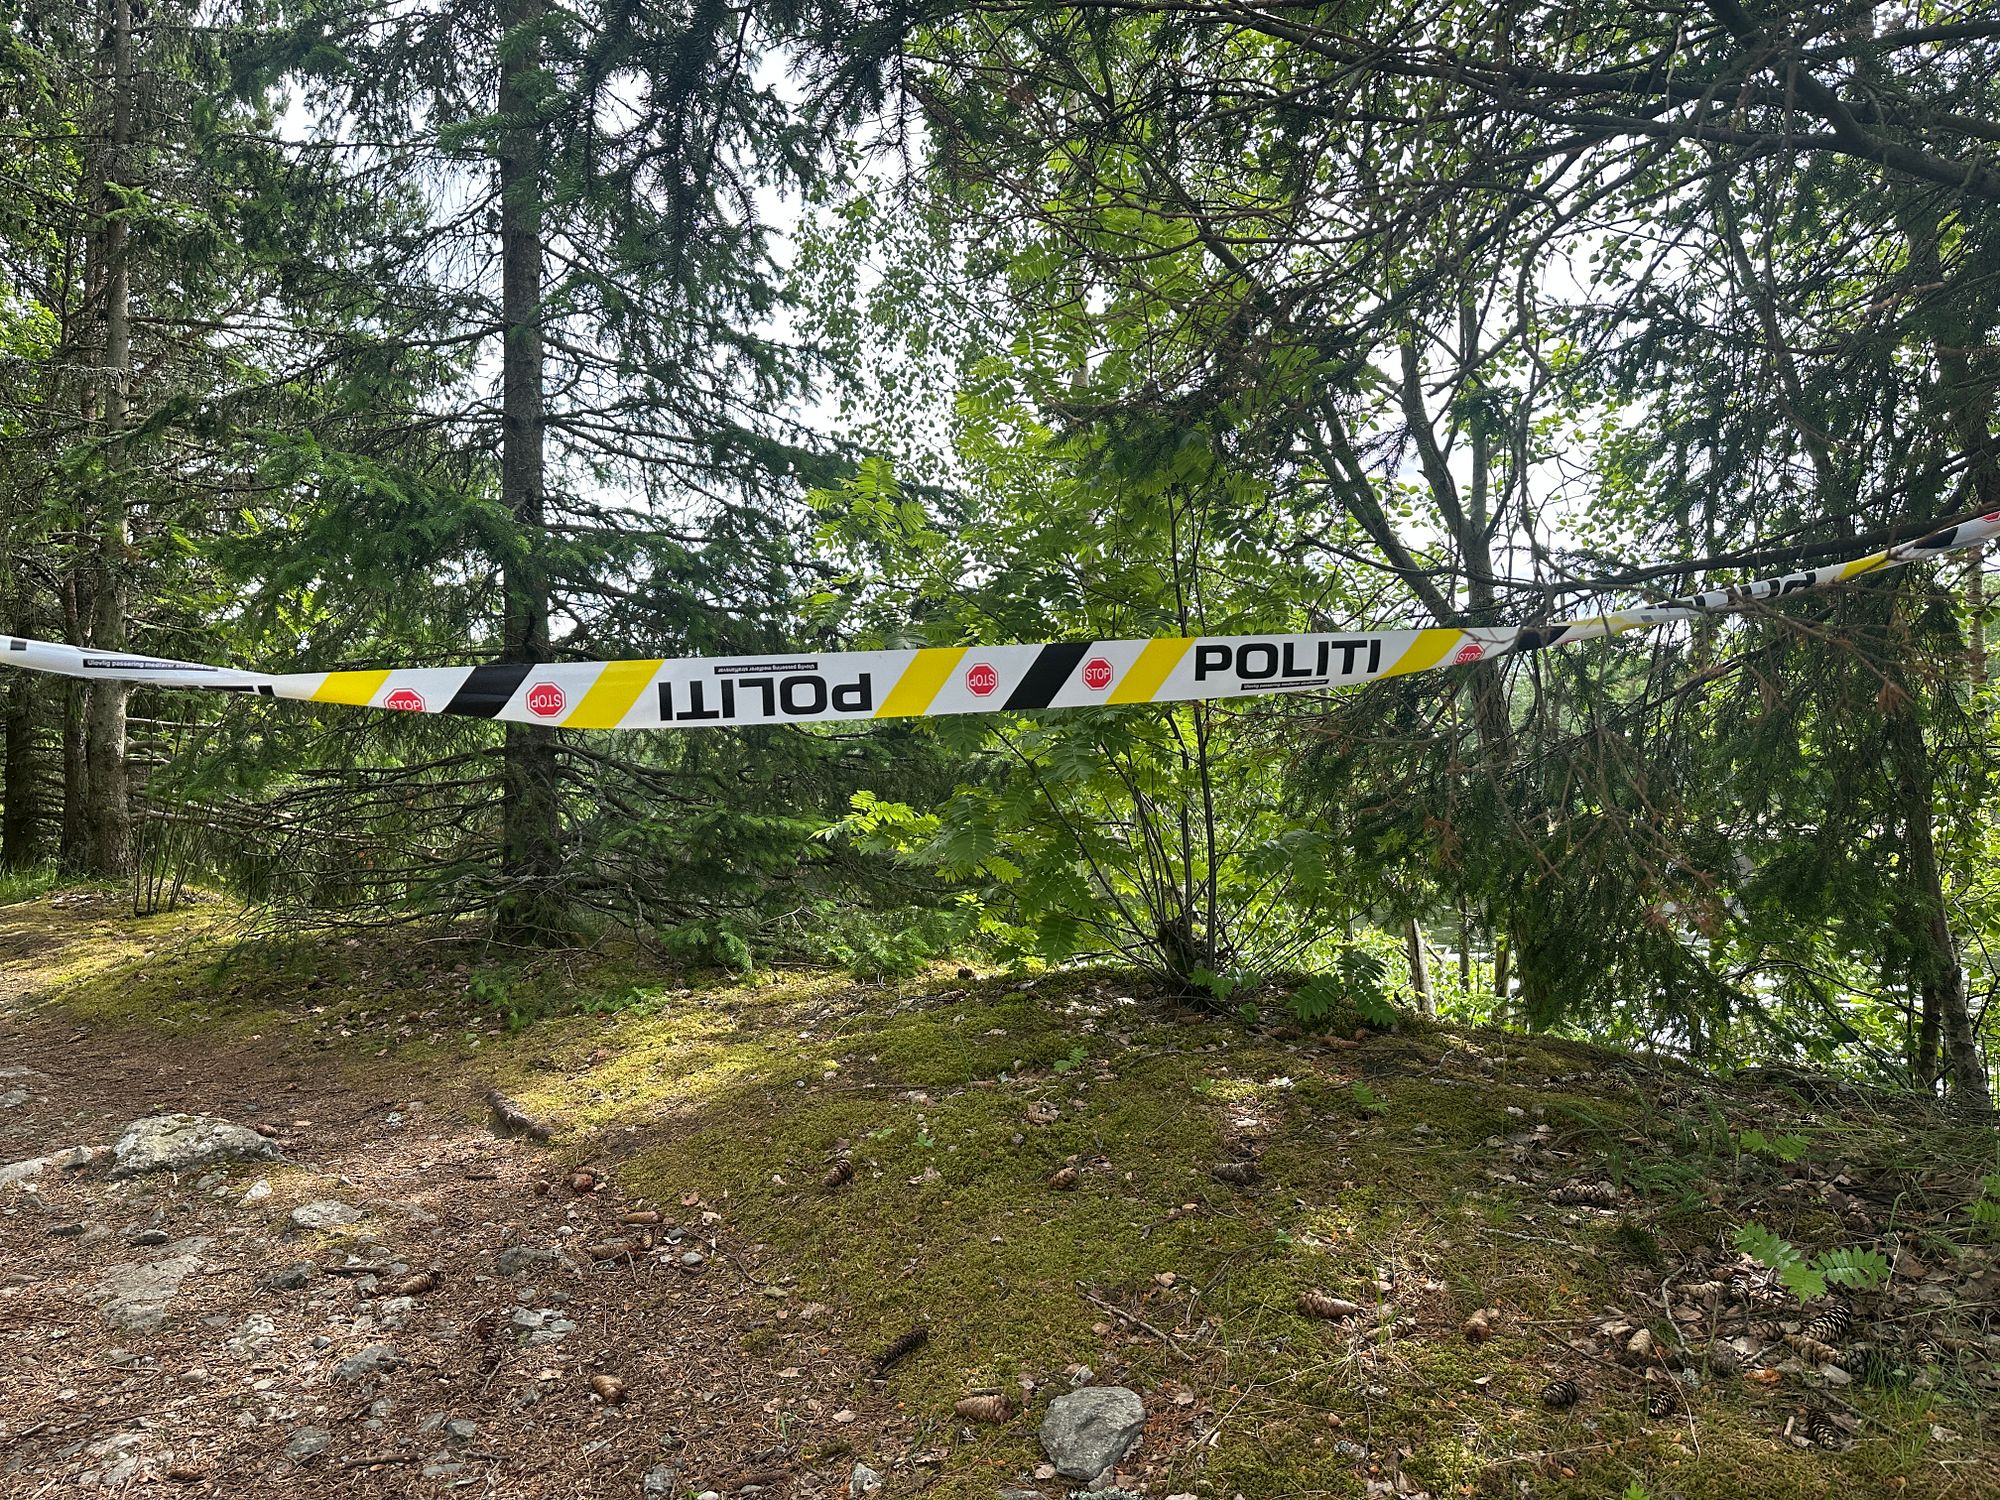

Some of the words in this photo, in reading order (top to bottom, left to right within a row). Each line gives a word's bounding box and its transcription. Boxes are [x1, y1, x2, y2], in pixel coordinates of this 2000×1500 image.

[111, 661, 144, 669] passering
[1195, 639, 1381, 681] POLITI
[969, 674, 995, 687] STOP
[1086, 668, 1110, 680] STOP
[531, 693, 562, 708] STOP
[658, 673, 873, 721] POLITI
[389, 700, 421, 712] STOP
